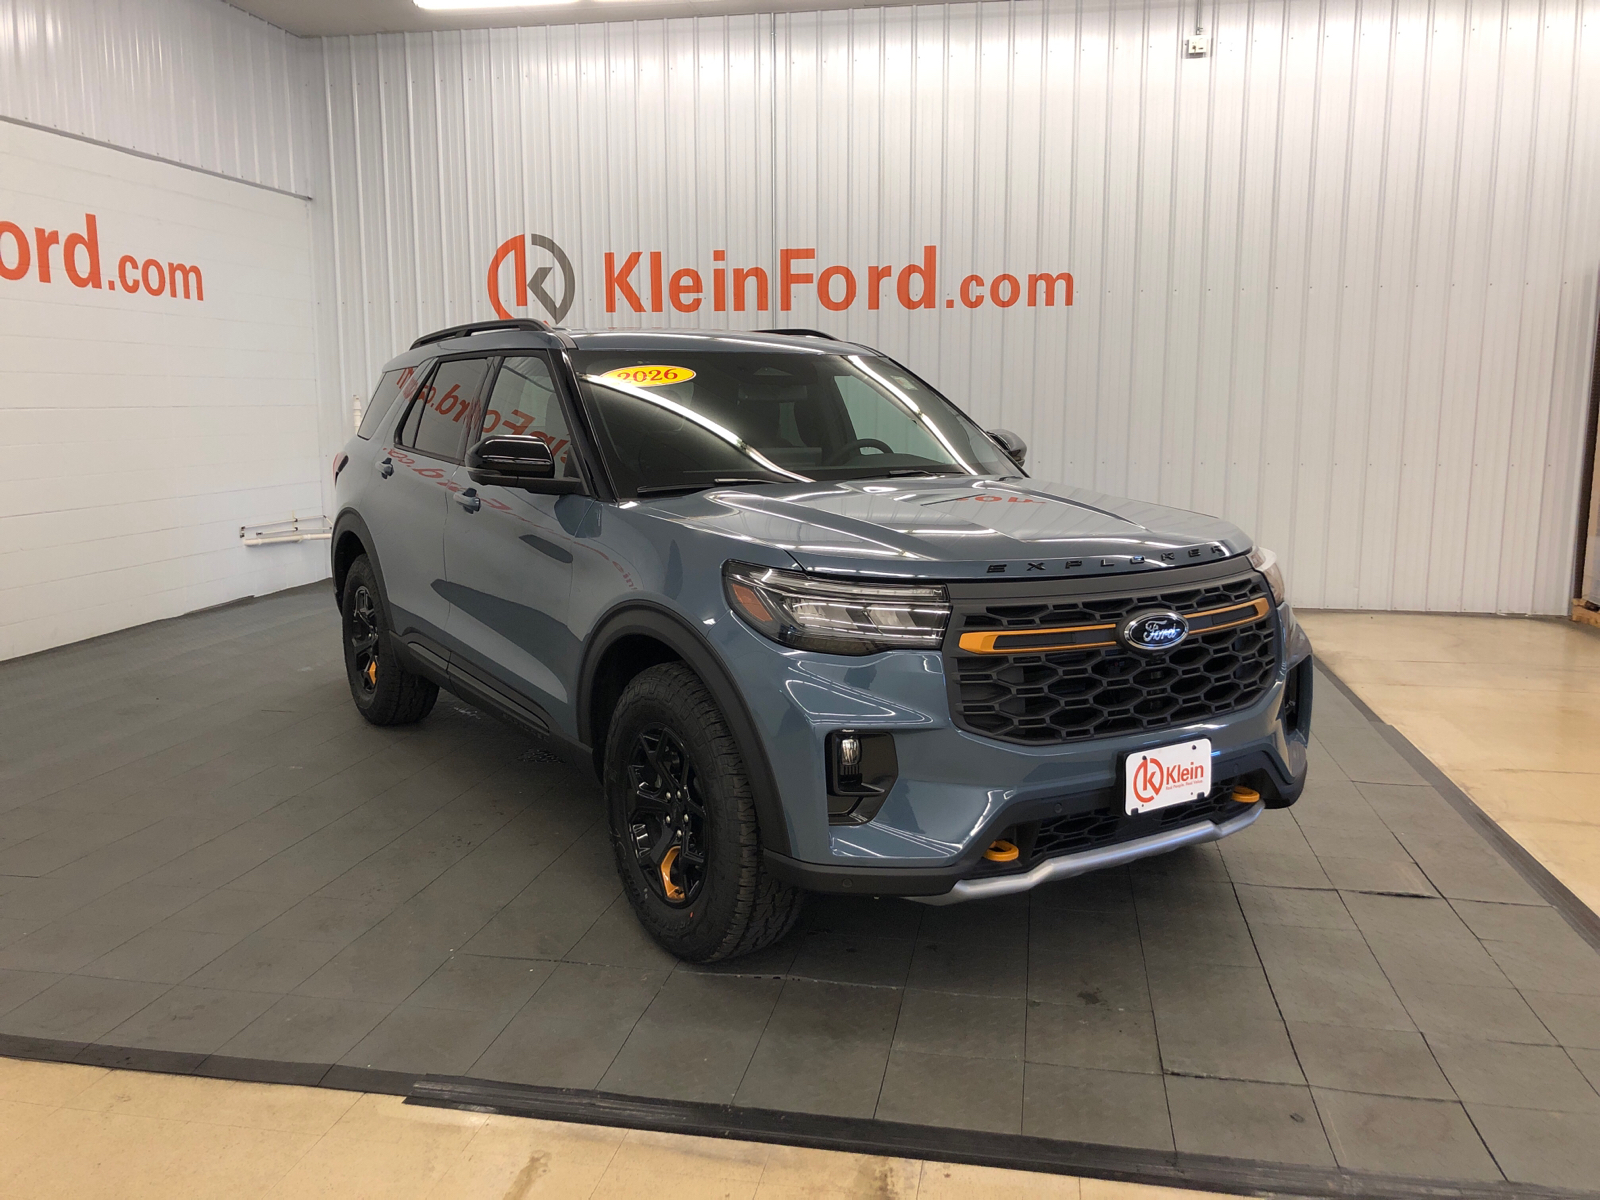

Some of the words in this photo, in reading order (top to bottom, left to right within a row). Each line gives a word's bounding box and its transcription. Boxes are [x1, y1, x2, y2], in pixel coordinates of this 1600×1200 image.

[0, 213, 204, 301] ord.com
[604, 245, 1074, 314] KleinFord.com
[617, 367, 678, 382] 2026
[986, 545, 1223, 574] EXPLORER
[1143, 620, 1181, 642] Ford
[1166, 762, 1204, 785] Klein
